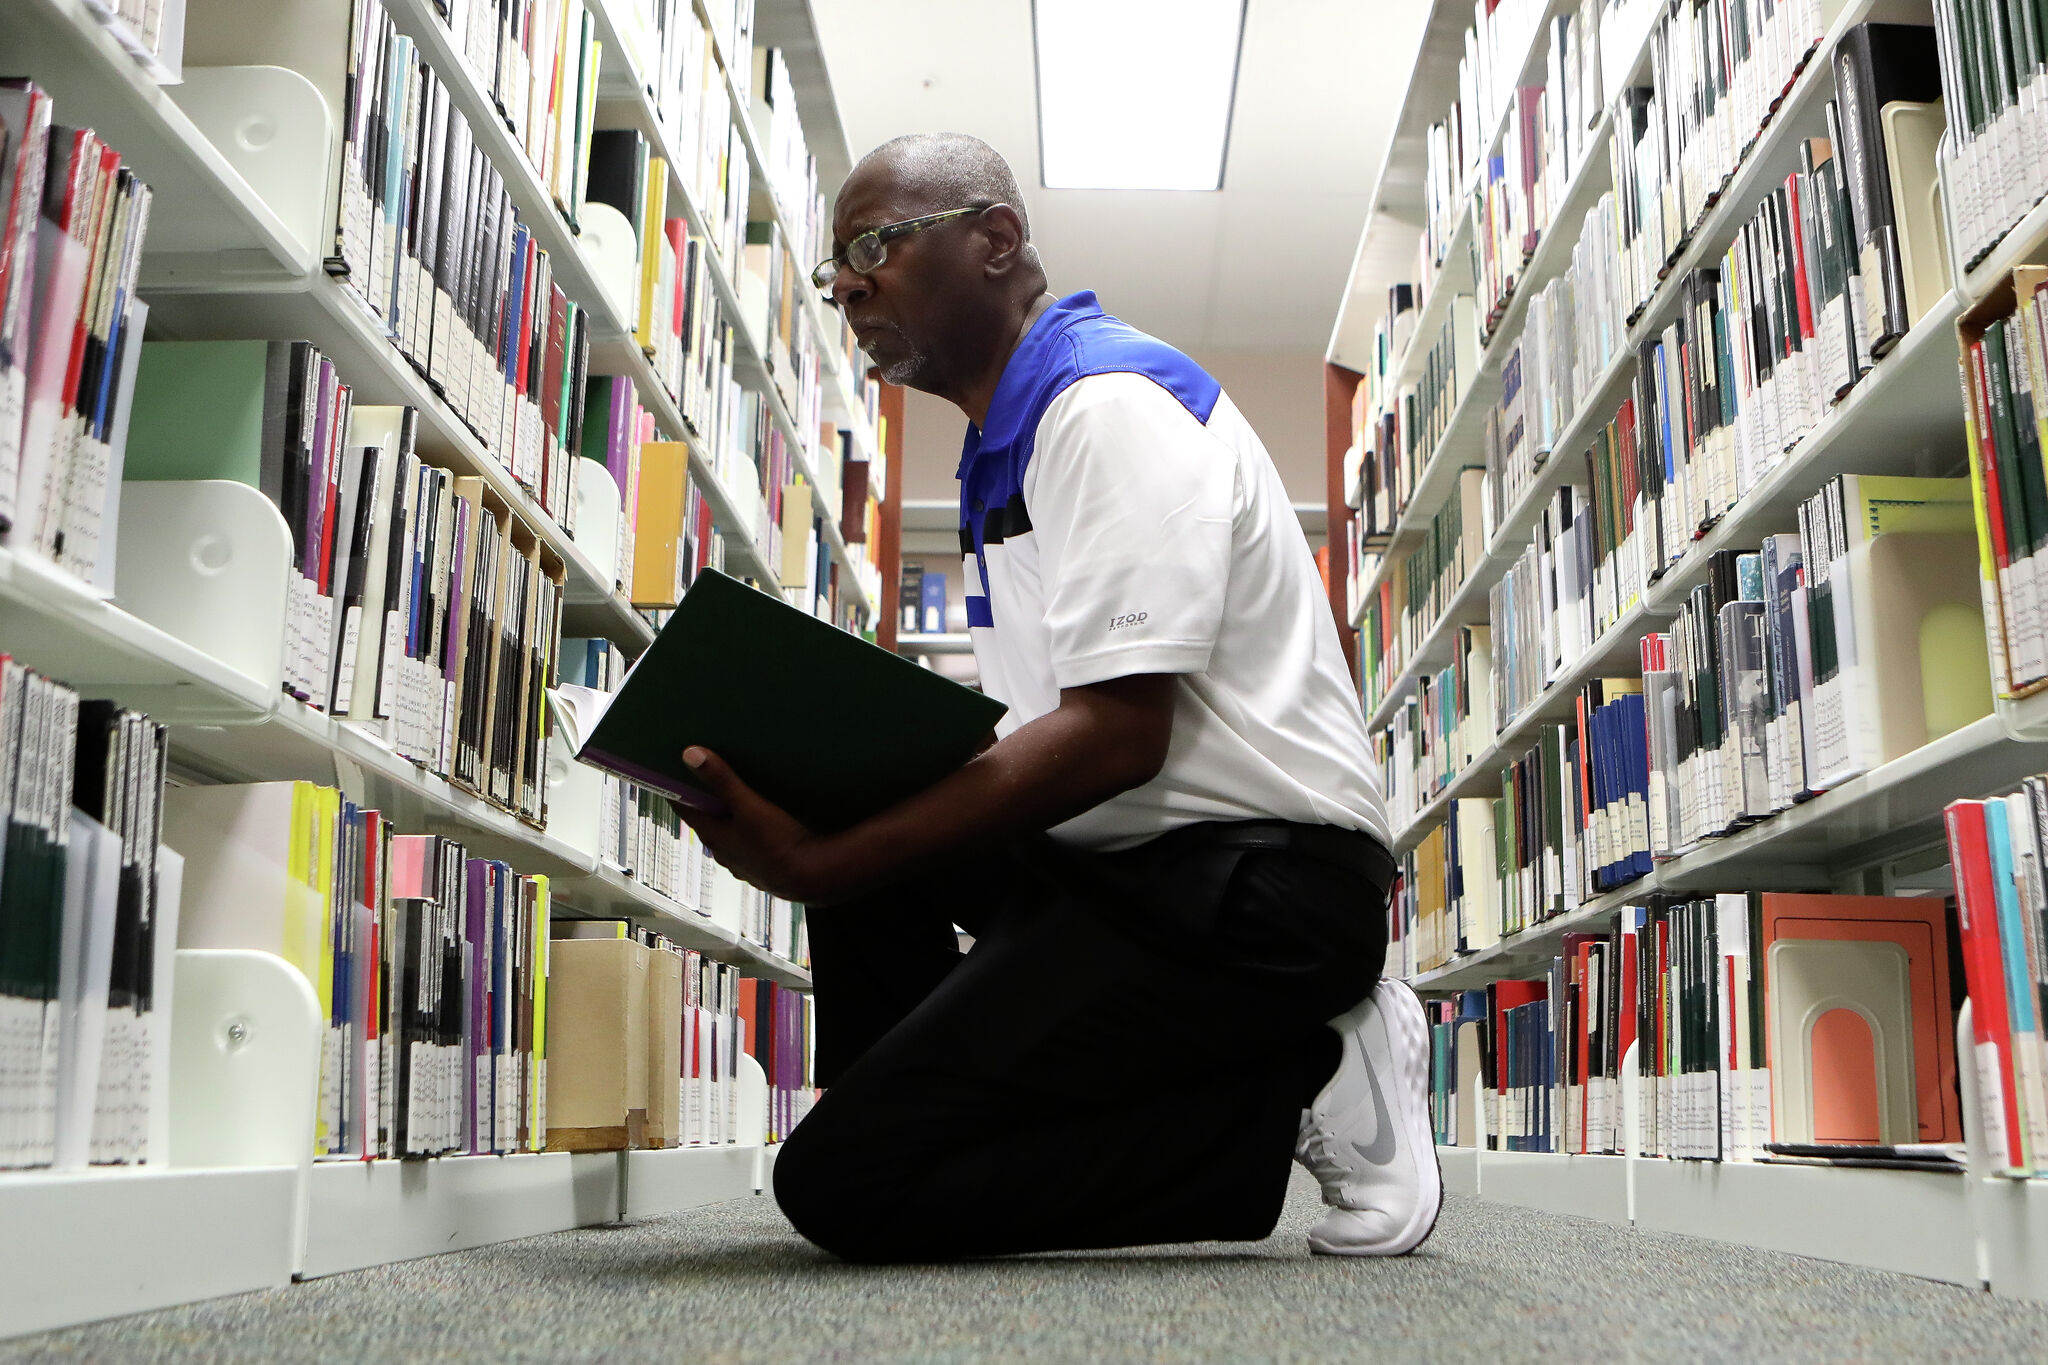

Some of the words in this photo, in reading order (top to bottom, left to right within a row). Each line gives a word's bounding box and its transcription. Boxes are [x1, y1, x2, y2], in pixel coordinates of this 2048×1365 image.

[1841, 54, 1856, 102] Caswell
[1849, 104, 1863, 151] County
[1854, 153, 1867, 211] Heritage
[438, 554, 446, 595] NEWTON
[1109, 612, 1148, 628] IZOD
[1713, 619, 1721, 661] County
[1647, 905, 1656, 950] Cherokee
